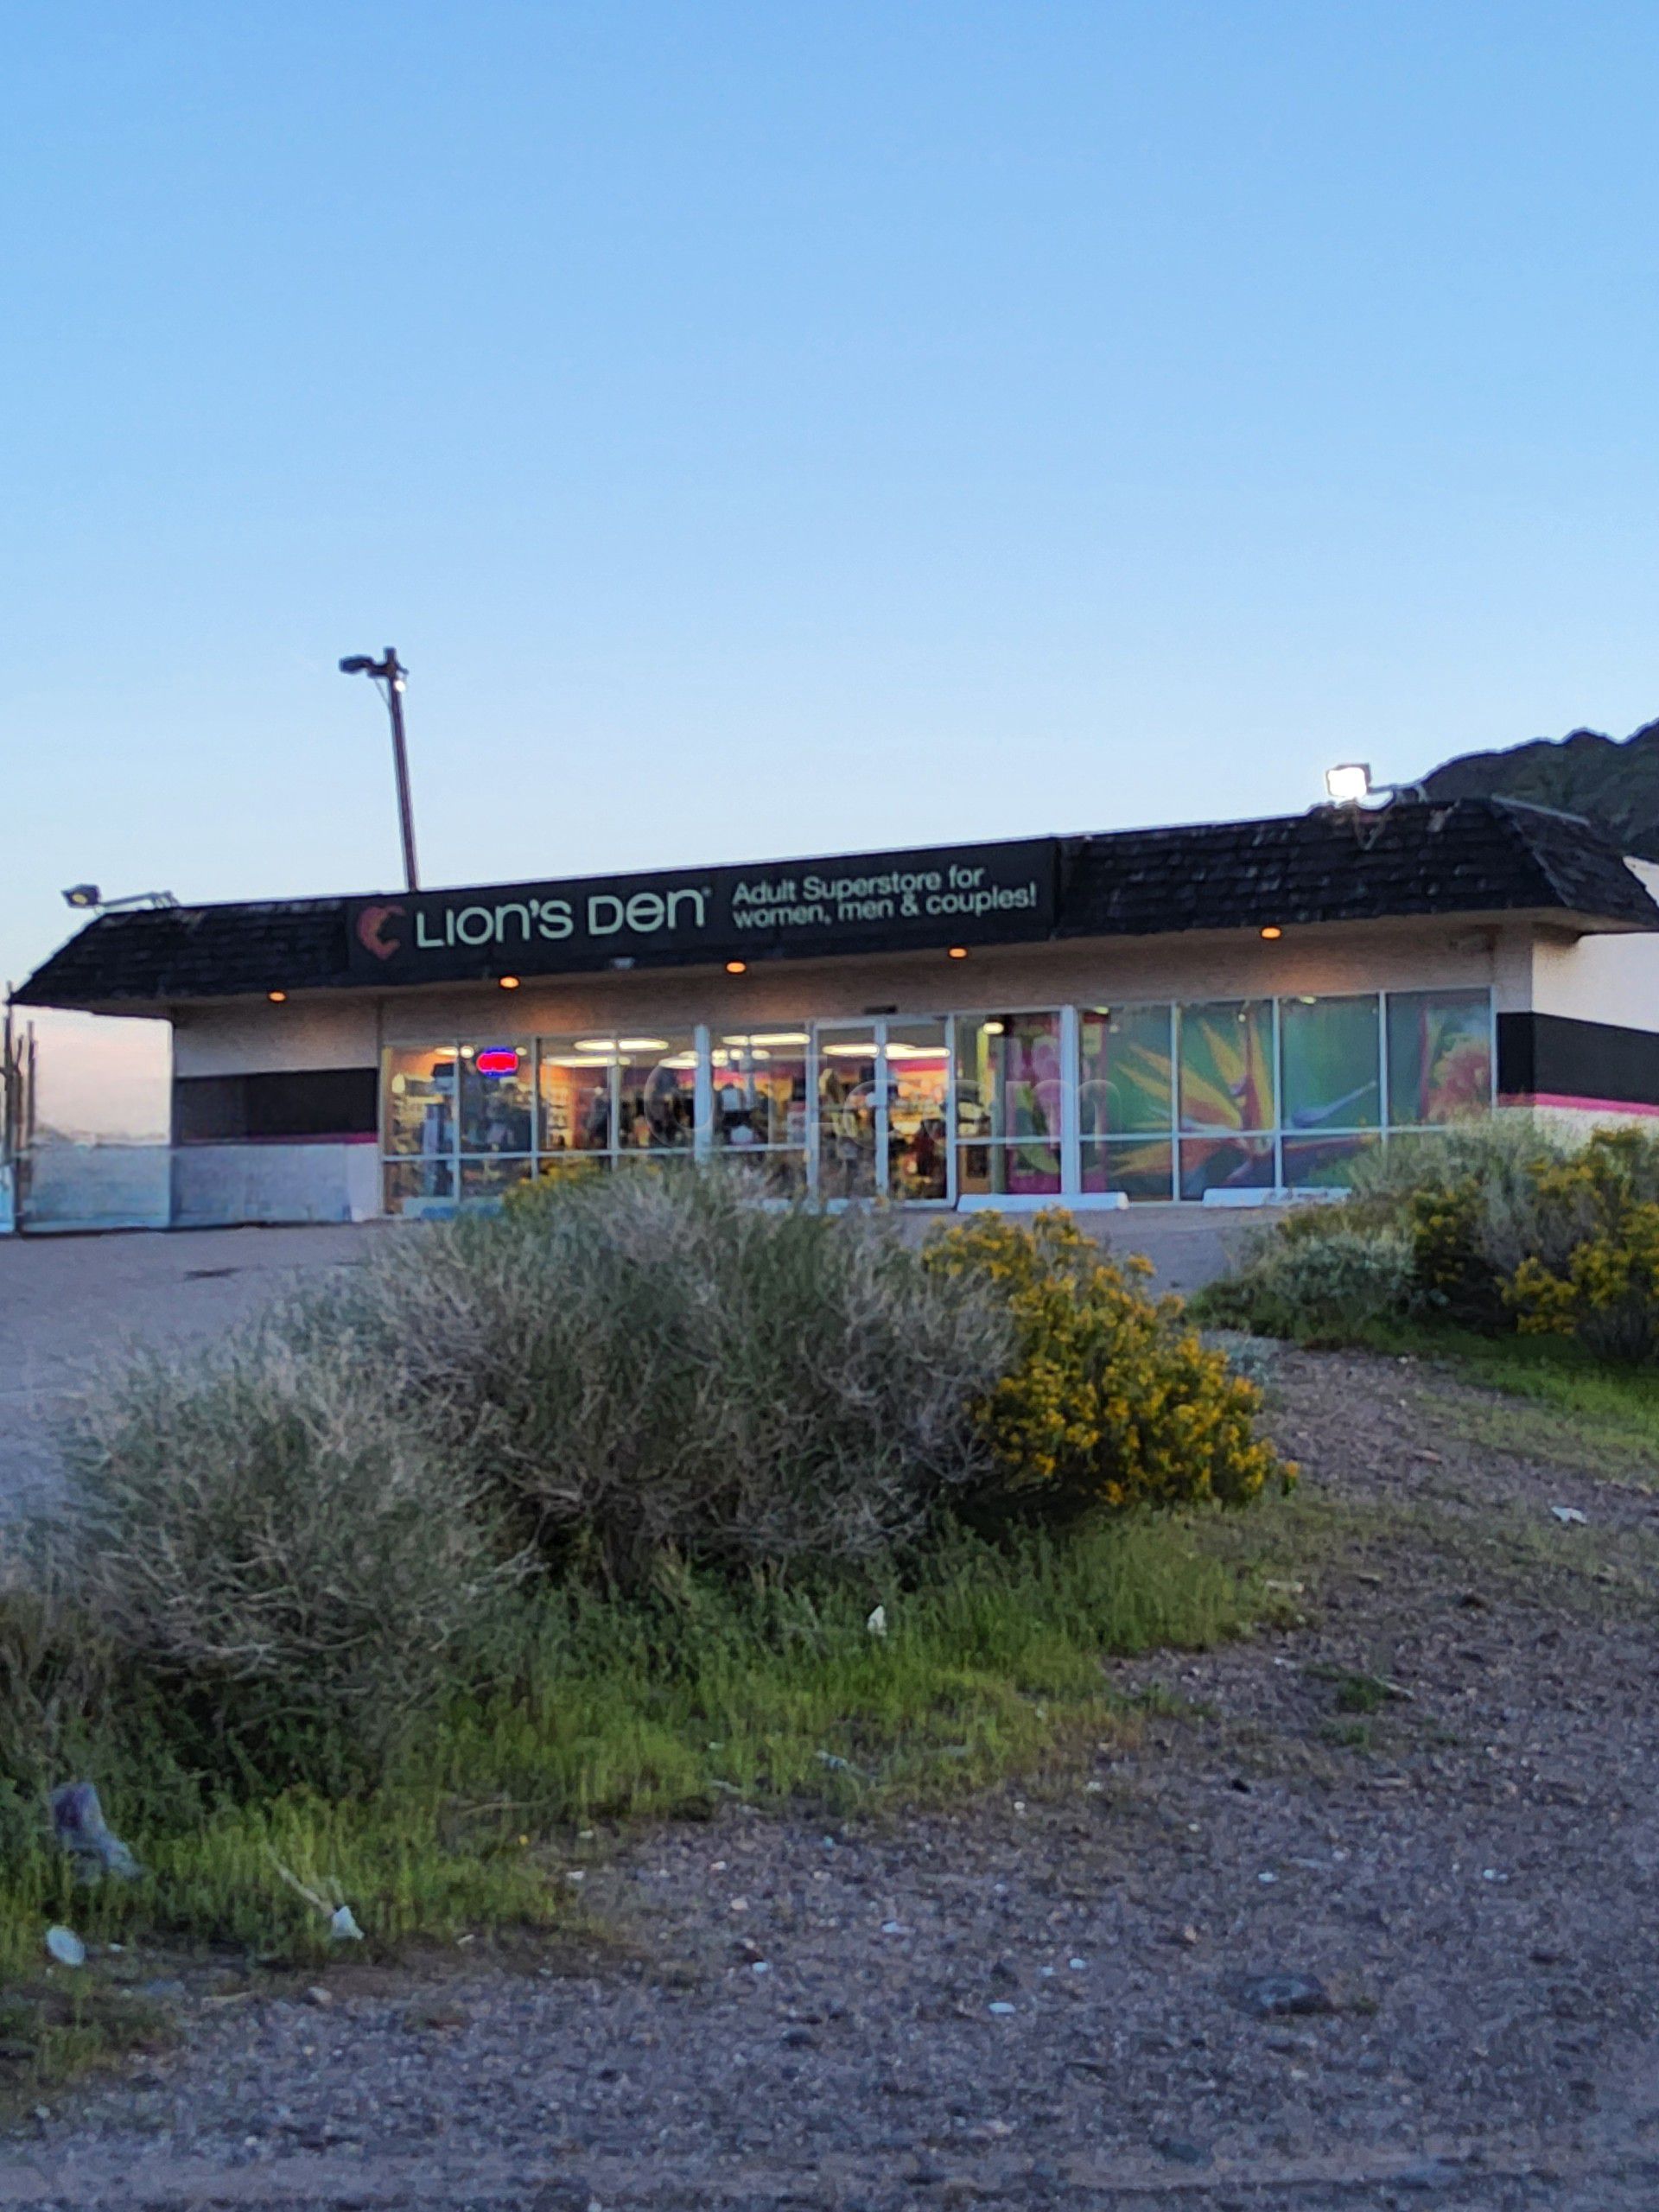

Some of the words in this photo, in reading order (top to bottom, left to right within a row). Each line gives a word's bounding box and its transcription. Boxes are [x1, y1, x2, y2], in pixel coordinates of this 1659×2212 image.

[732, 880, 797, 906] Adult
[802, 871, 942, 901] Superstore
[949, 863, 985, 889] for
[732, 903, 833, 930] women,
[836, 899, 895, 921] men
[899, 891, 920, 917] &
[925, 882, 1037, 917] couples!
